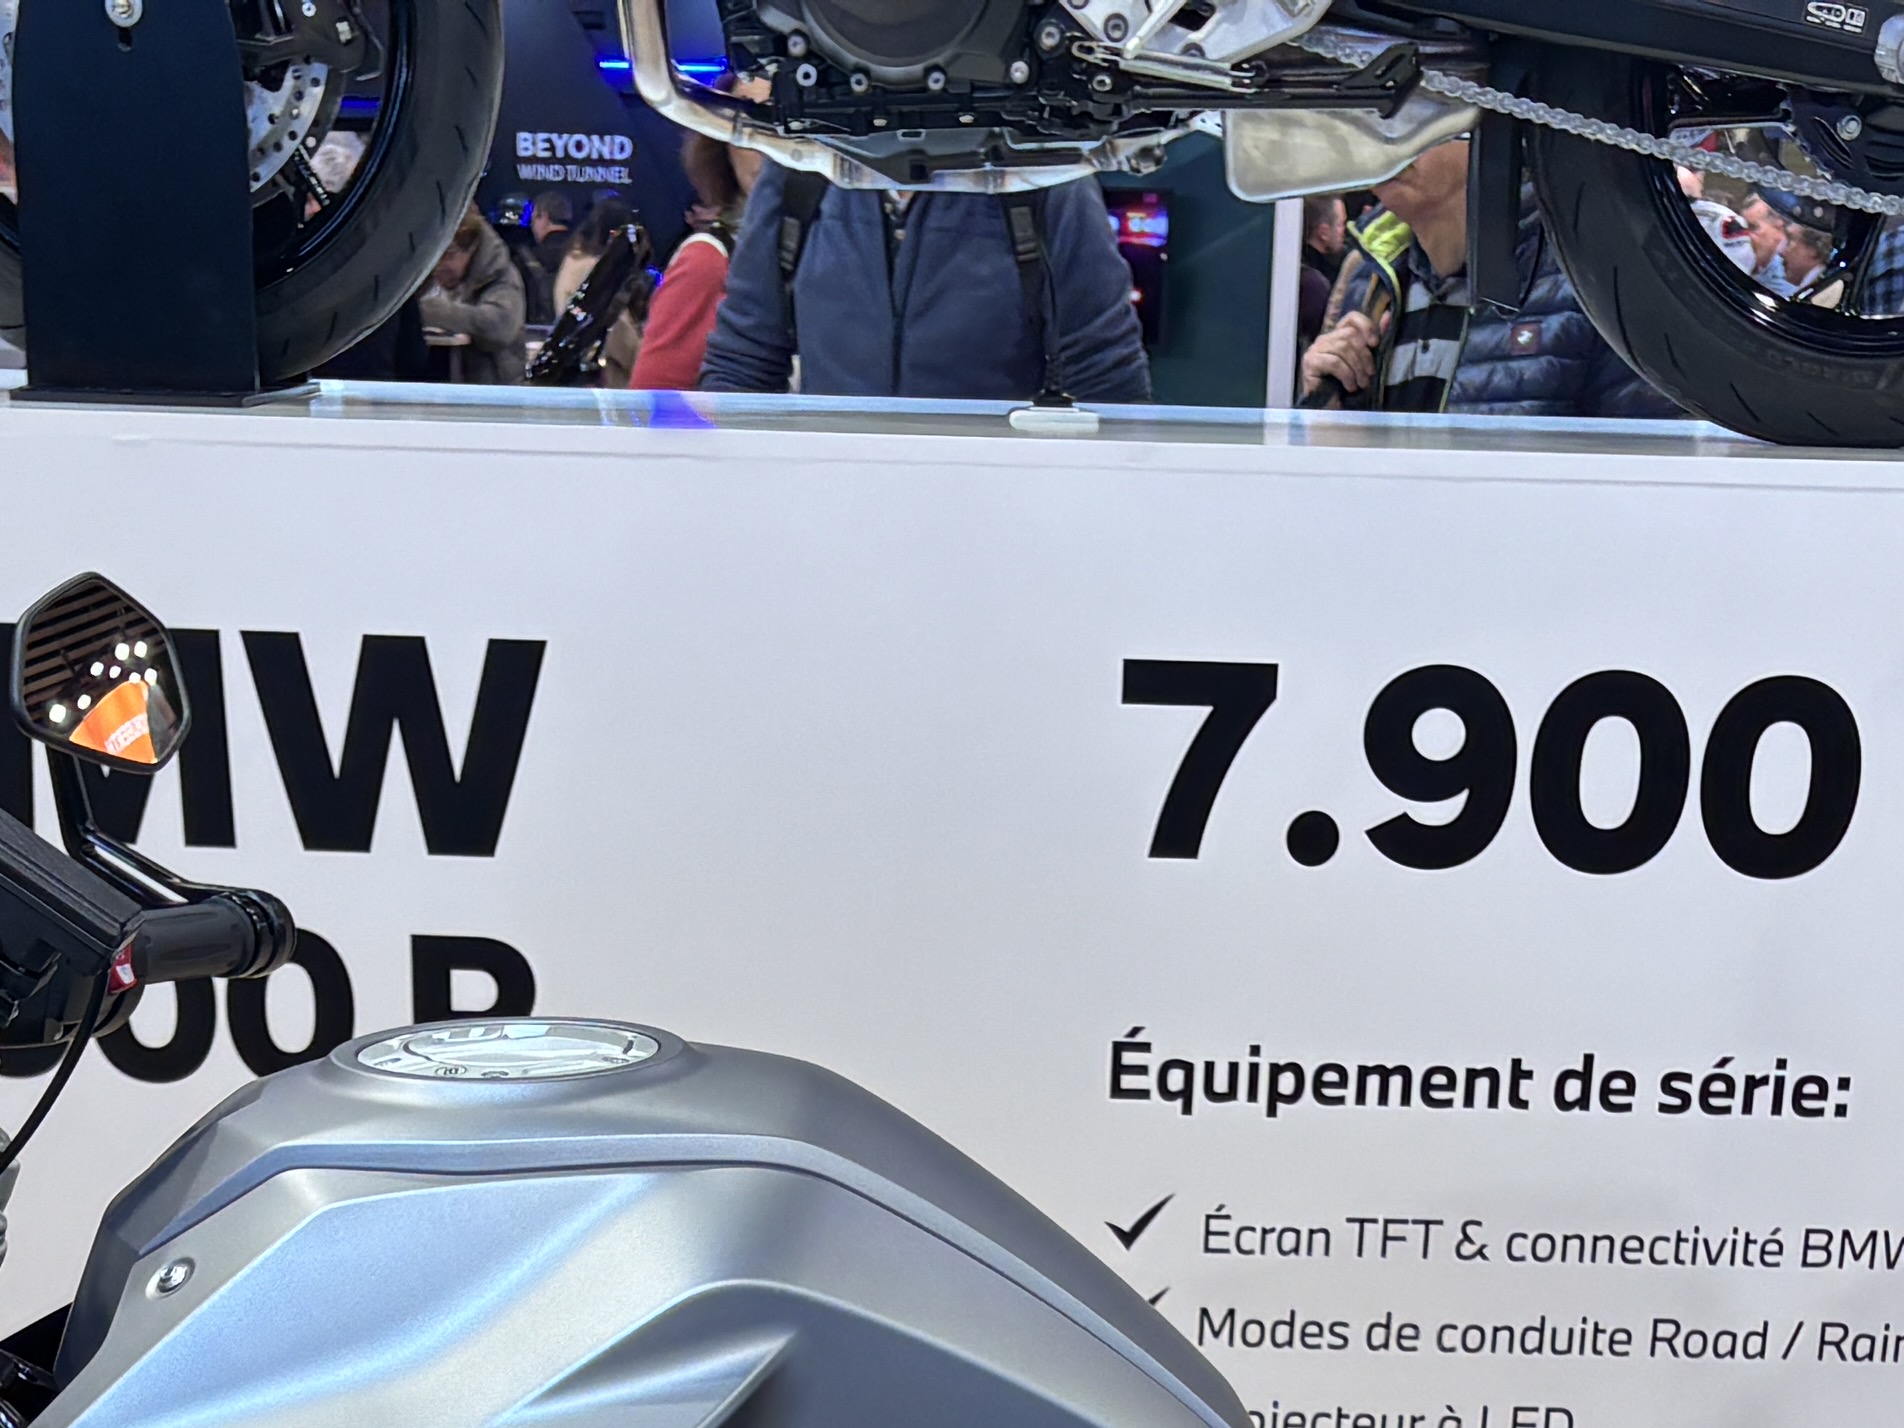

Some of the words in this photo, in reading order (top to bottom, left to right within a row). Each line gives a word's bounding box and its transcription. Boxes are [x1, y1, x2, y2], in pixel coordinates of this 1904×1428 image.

[515, 131, 633, 160] BEYOND
[1121, 658, 1862, 880] 7.900
[0, 928, 355, 1083] 00
[1109, 1026, 1534, 1118] Équipement
[1553, 1053, 1637, 1114] de
[1657, 1056, 1851, 1118] série:
[1203, 1204, 1331, 1257] Écran
[1345, 1217, 1444, 1260] TFT
[1455, 1219, 1489, 1261] &
[1506, 1225, 1784, 1268] connectivité
[1196, 1307, 1350, 1352] Modes
[1366, 1311, 1420, 1352] de
[1436, 1315, 1633, 1357] conduite
[1649, 1318, 1769, 1360] Road
[1781, 1320, 1804, 1360] /
